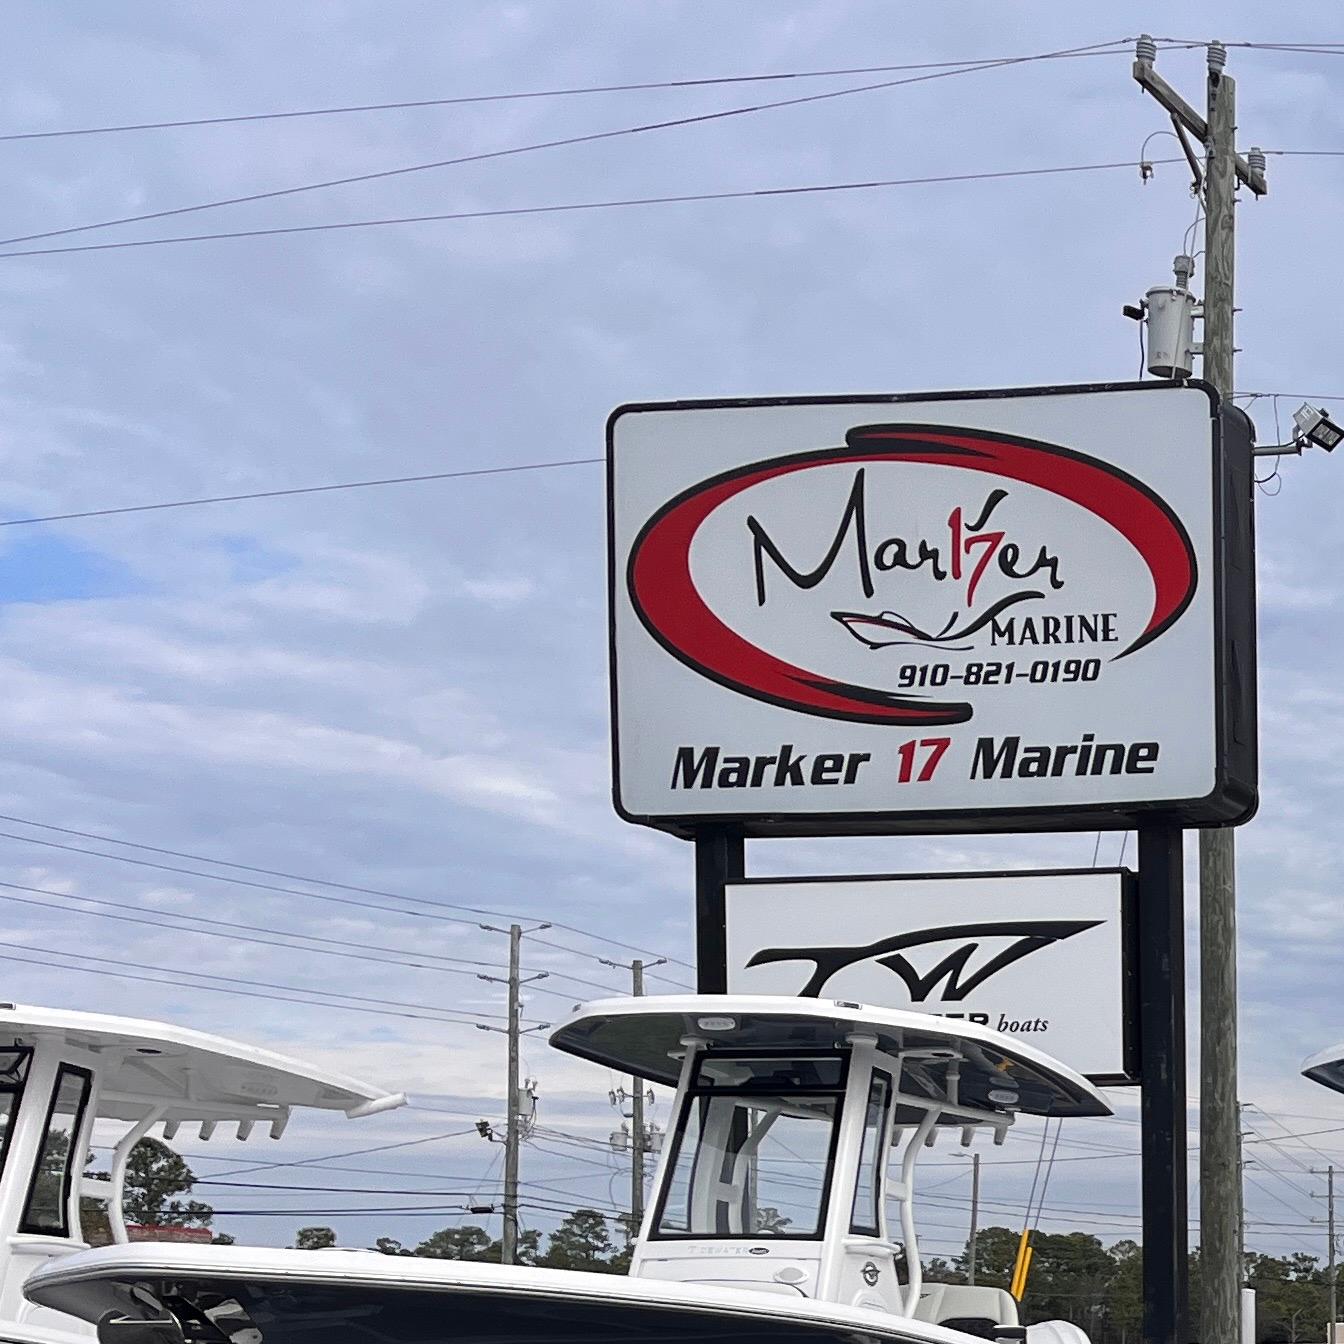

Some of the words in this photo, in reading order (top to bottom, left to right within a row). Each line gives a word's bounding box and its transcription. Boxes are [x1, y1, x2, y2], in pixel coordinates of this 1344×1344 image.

[990, 613, 1118, 647] MARINE
[898, 658, 1101, 688] 910-821-0190
[671, 743, 870, 790] Marker
[898, 736, 951, 783] 17
[970, 732, 1159, 780] Marine
[997, 1014, 1049, 1033] boats
